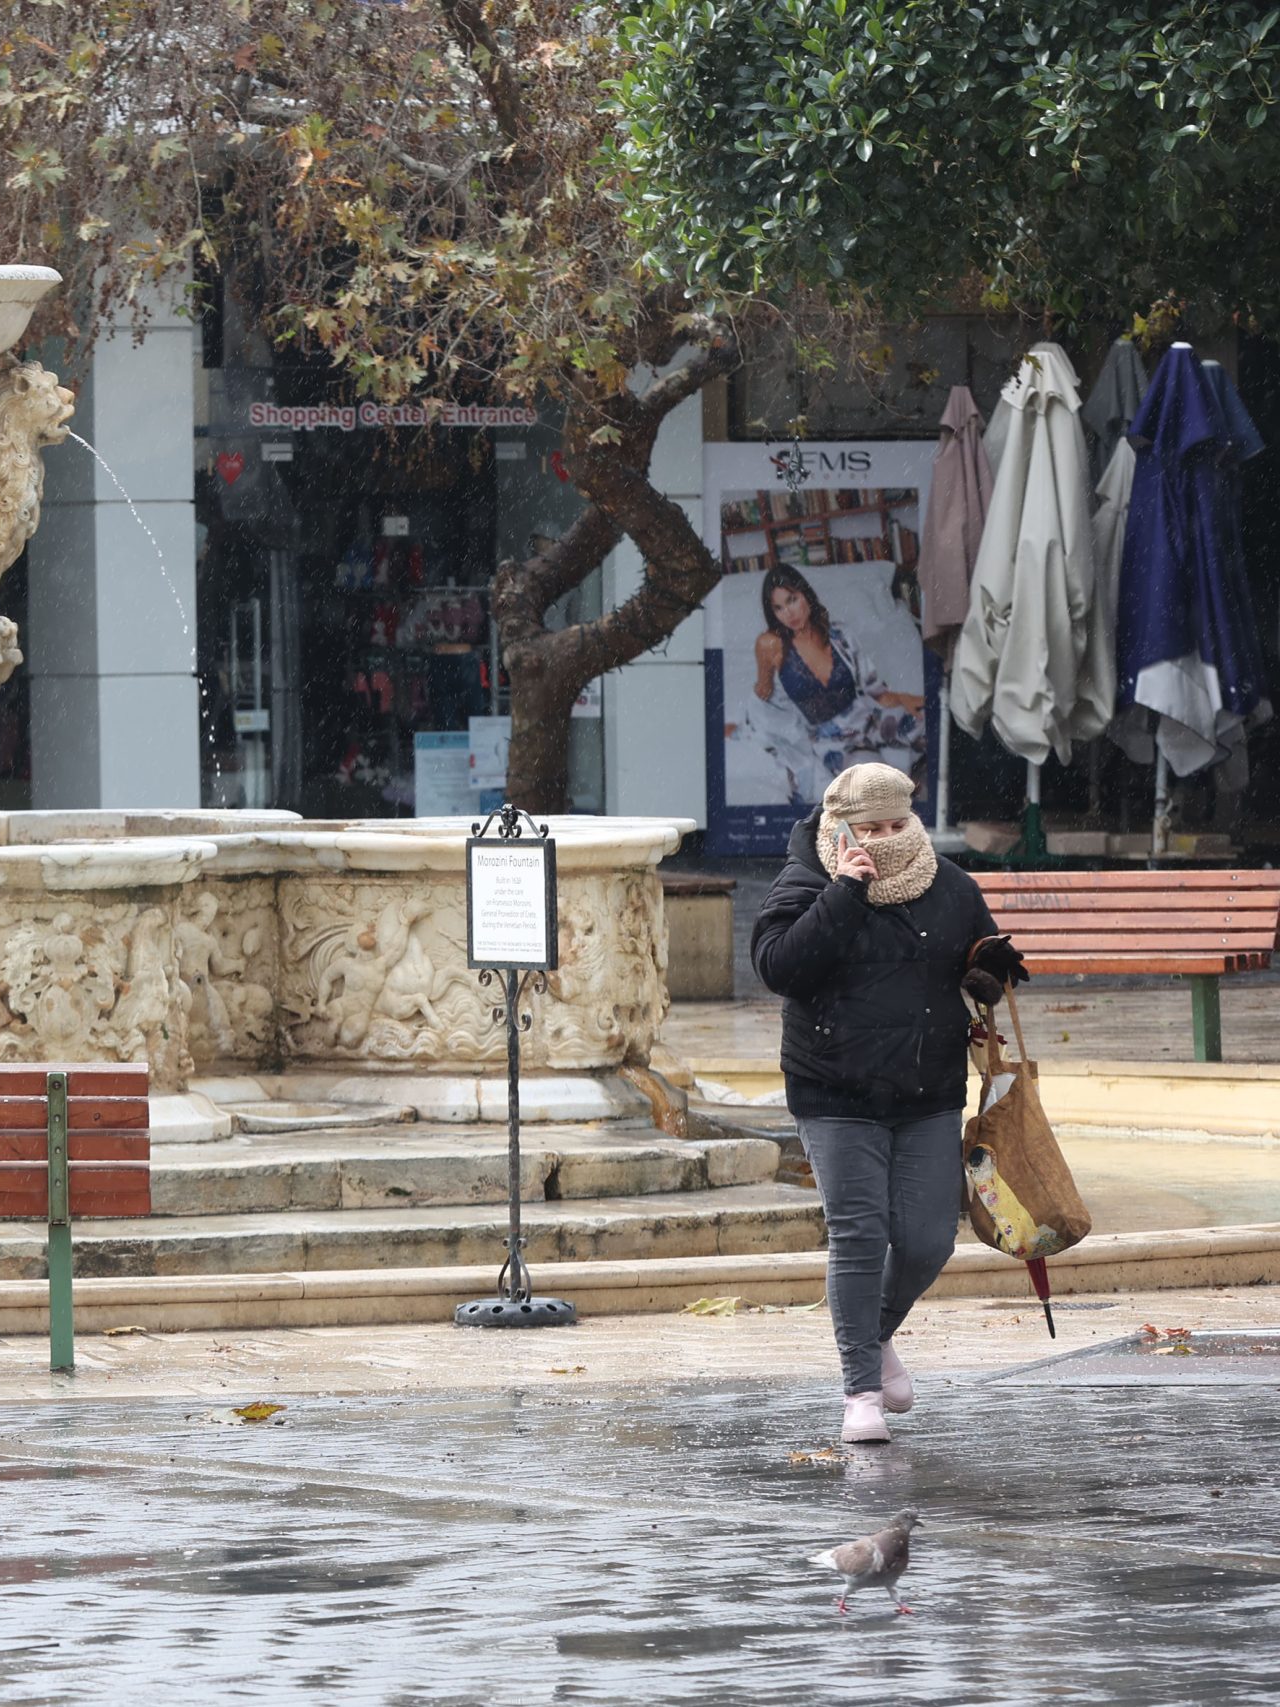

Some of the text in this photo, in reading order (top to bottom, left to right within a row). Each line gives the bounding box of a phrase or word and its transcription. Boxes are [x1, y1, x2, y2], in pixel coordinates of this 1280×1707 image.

[249, 403, 355, 431] Shopping
[439, 403, 538, 427] Entrance
[508, 855, 540, 868] Fountain
